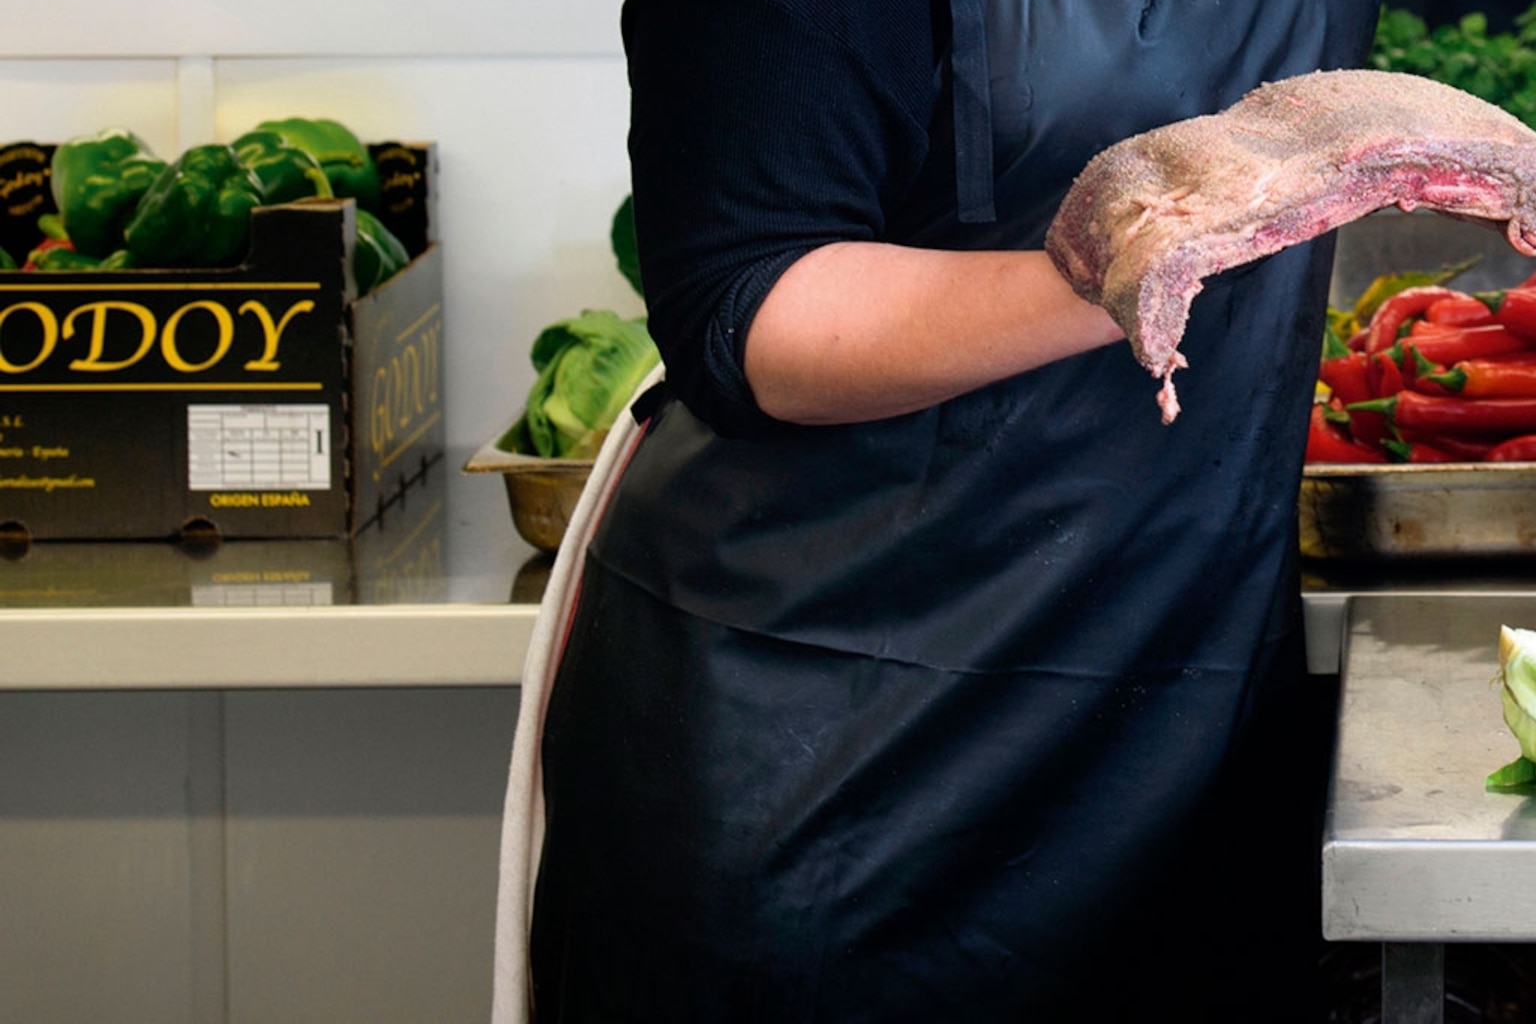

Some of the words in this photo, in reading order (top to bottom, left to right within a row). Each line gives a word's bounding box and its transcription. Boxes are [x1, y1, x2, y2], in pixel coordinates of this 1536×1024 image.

[0, 300, 316, 374] ODOY
[209, 493, 259, 508] ORIGEN
[261, 490, 310, 508] ESPAÑA
